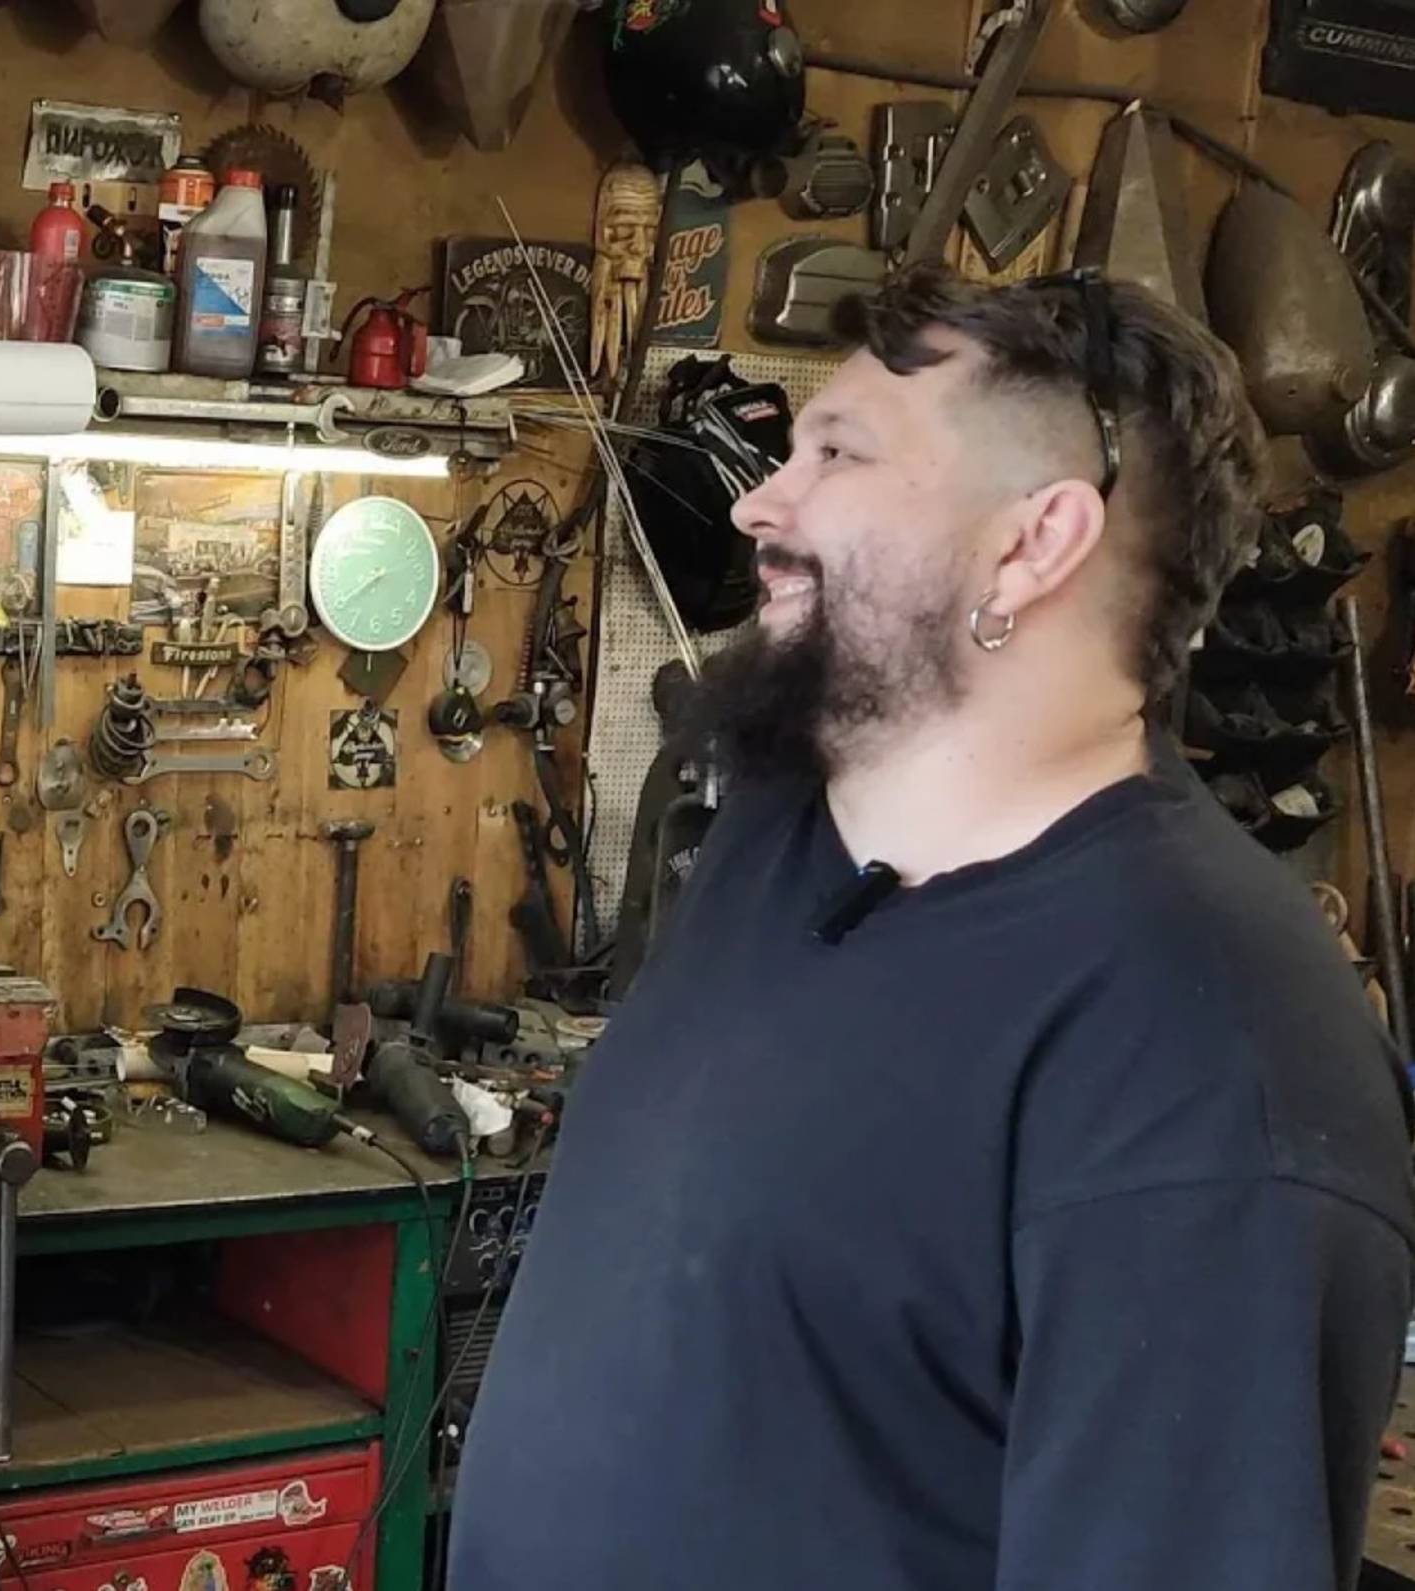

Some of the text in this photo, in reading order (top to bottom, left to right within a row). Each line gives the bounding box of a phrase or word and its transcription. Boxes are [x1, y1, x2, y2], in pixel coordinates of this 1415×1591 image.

[451, 245, 593, 295] LEGENDS NEVER DI
[379, 430, 422, 454] Ford
[177, 1496, 253, 1517] MY WELDER
